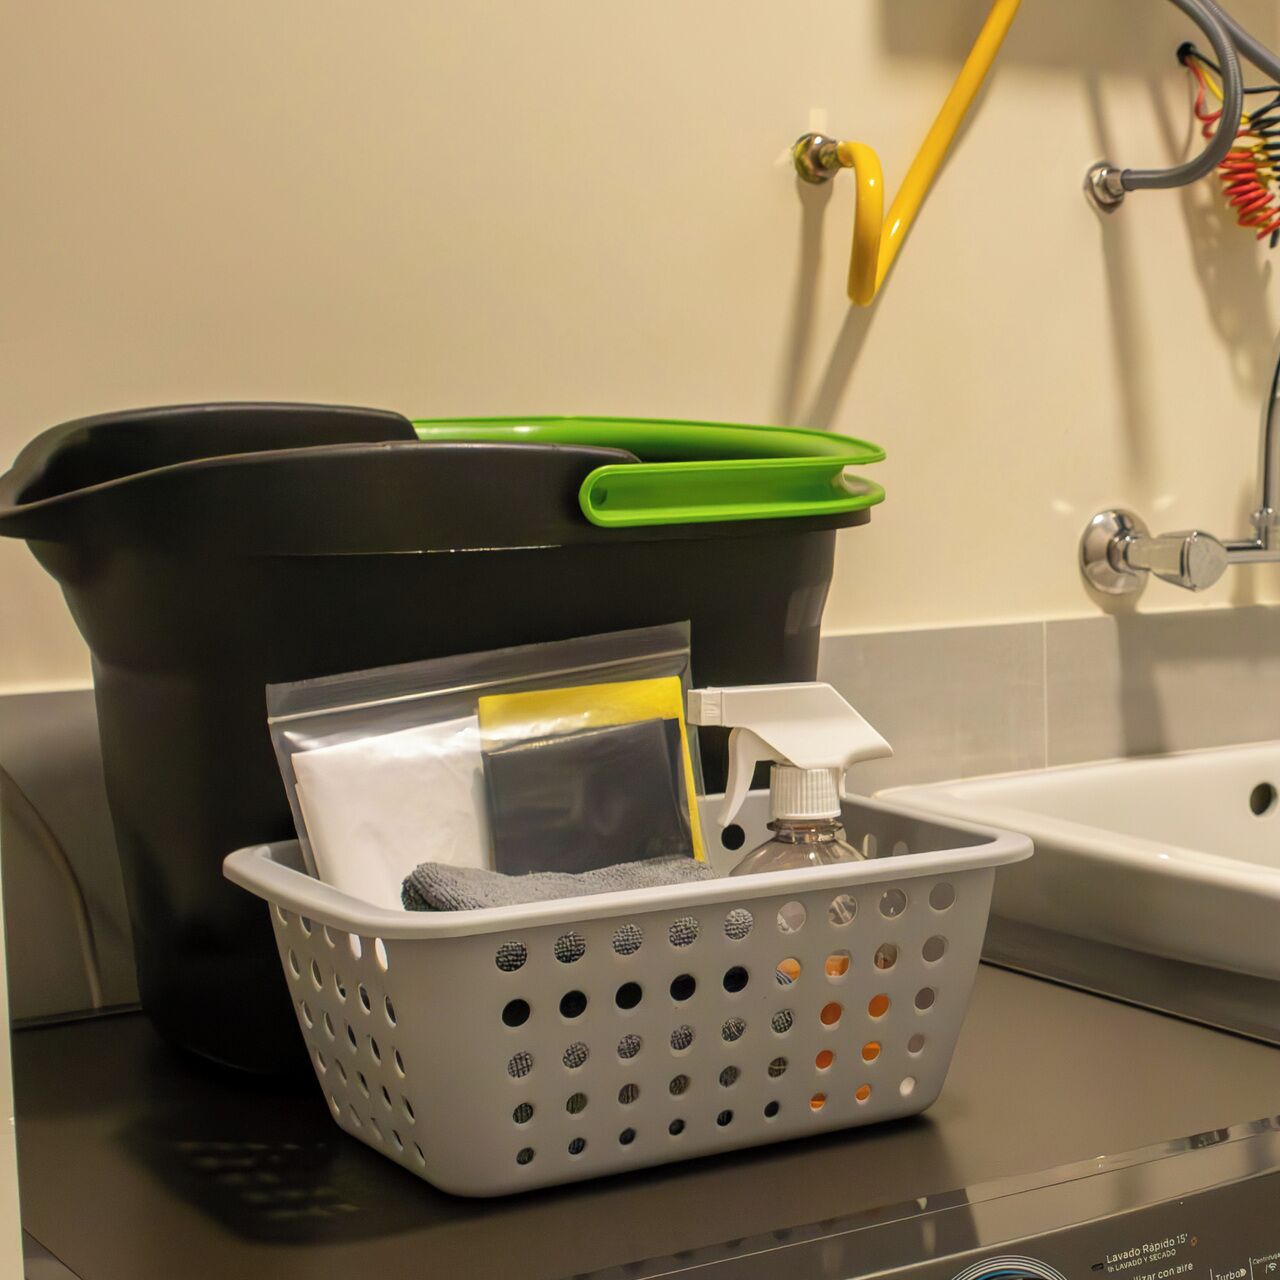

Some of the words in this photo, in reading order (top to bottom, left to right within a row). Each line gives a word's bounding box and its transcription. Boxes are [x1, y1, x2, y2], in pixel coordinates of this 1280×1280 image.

[1106, 1248, 1141, 1264] Lavado
[1115, 1258, 1142, 1271] LAVADO
[1149, 1249, 1176, 1262] SECADO
[1157, 1267, 1175, 1279] con
[1176, 1262, 1194, 1274] aire
